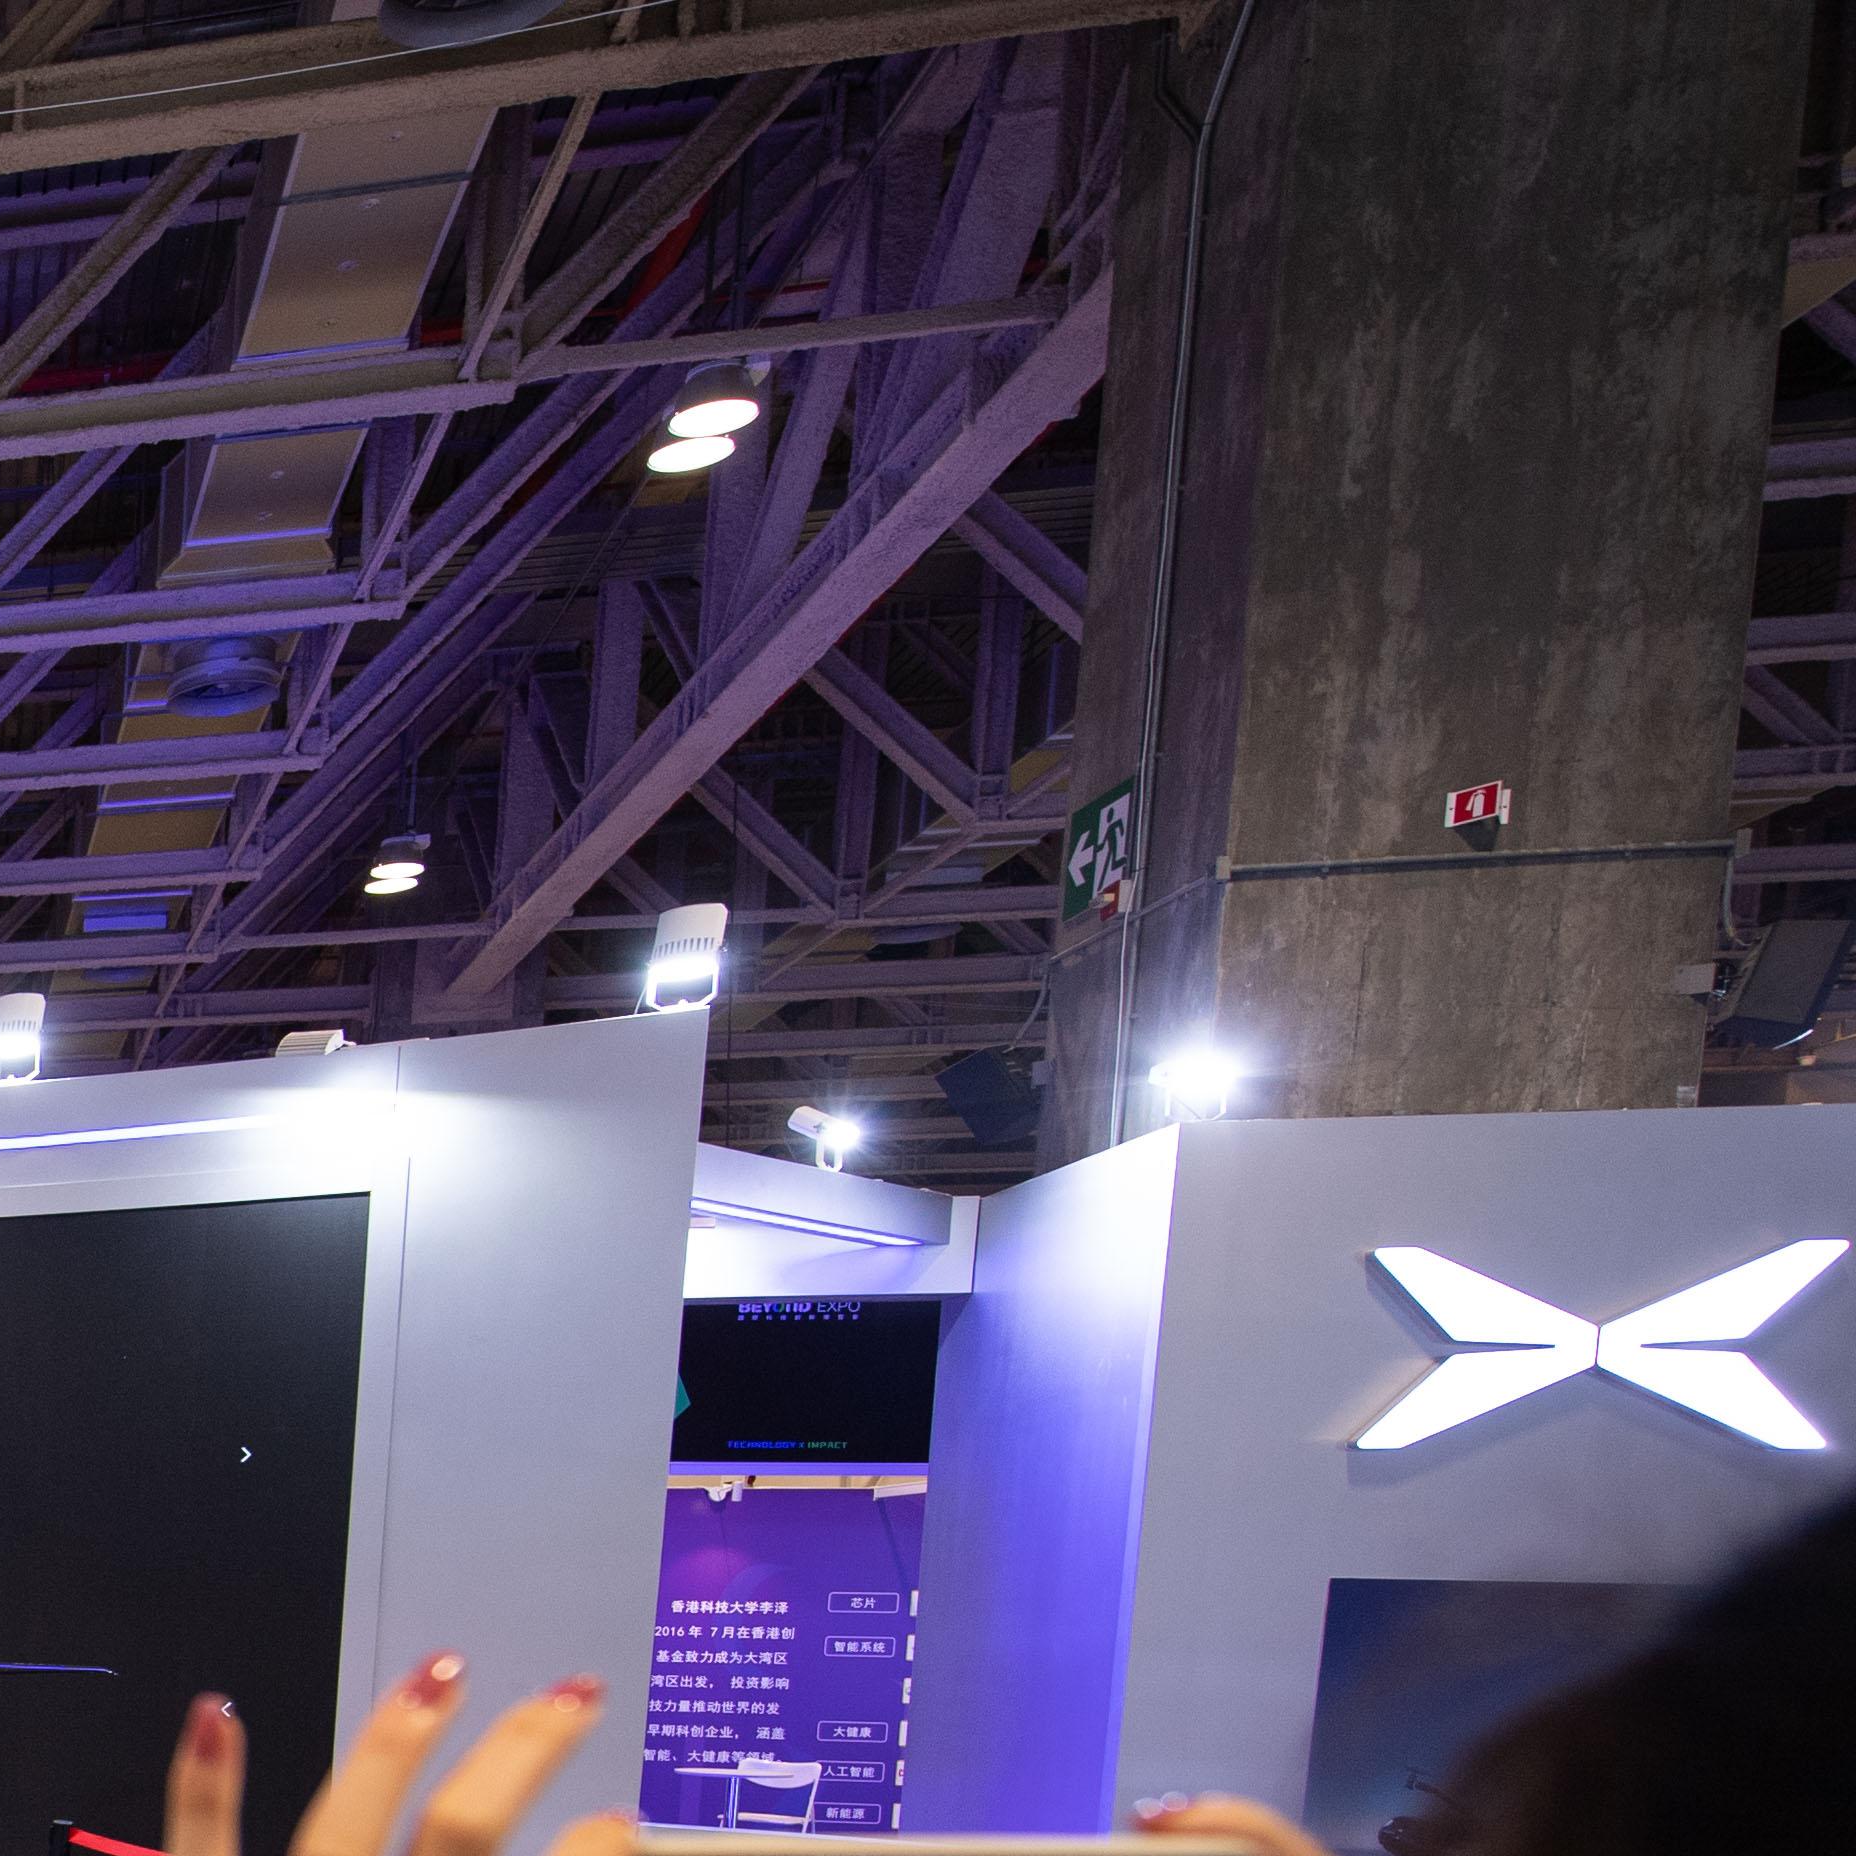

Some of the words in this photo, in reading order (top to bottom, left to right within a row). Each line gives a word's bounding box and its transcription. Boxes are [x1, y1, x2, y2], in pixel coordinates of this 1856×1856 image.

[817, 1301, 861, 1313] EXPO
[807, 1441, 848, 1449] IMPACT
[671, 1600, 789, 1615] 香港科技大学李泽
[851, 1597, 877, 1610] 芯片
[833, 1641, 886, 1654] 智能系统
[656, 1650, 788, 1665] 基金致力成为大湾区
[648, 1699, 781, 1716] 技力量推动世界的发
[833, 1725, 873, 1739] 大健康
[823, 1764, 876, 1779] 人工智能
[826, 1807, 866, 1820] 新能源
